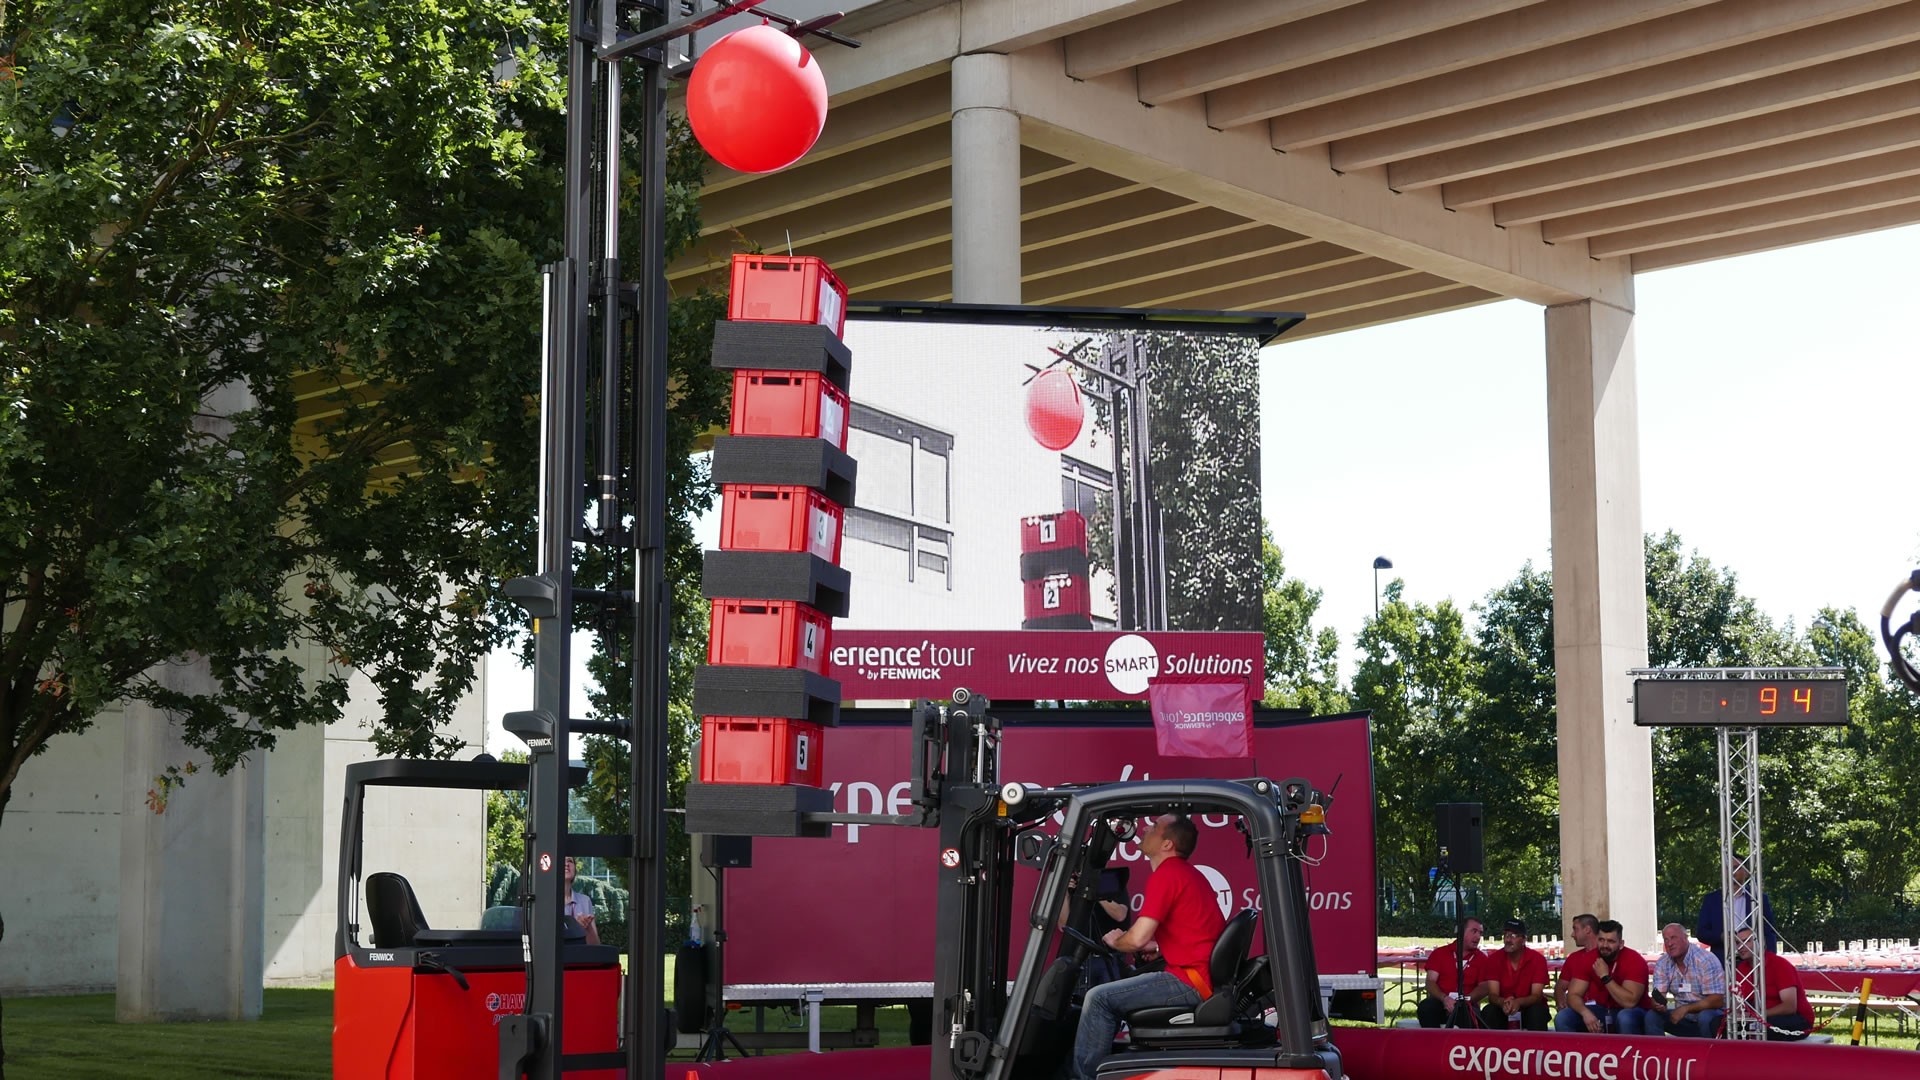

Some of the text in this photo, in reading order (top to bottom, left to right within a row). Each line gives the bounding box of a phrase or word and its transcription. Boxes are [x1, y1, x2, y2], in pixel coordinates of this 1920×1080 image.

[1044, 524, 1051, 539] 1
[1047, 588, 1056, 605] 2
[806, 627, 814, 653] 4
[830, 640, 976, 667] erience'tour
[1008, 652, 1254, 675] Vivez nos SMART Solutions
[866, 668, 942, 681] by FENWICK
[527, 737, 552, 747] FENWICK
[799, 740, 806, 765] 5
[369, 952, 395, 961] FENWICK
